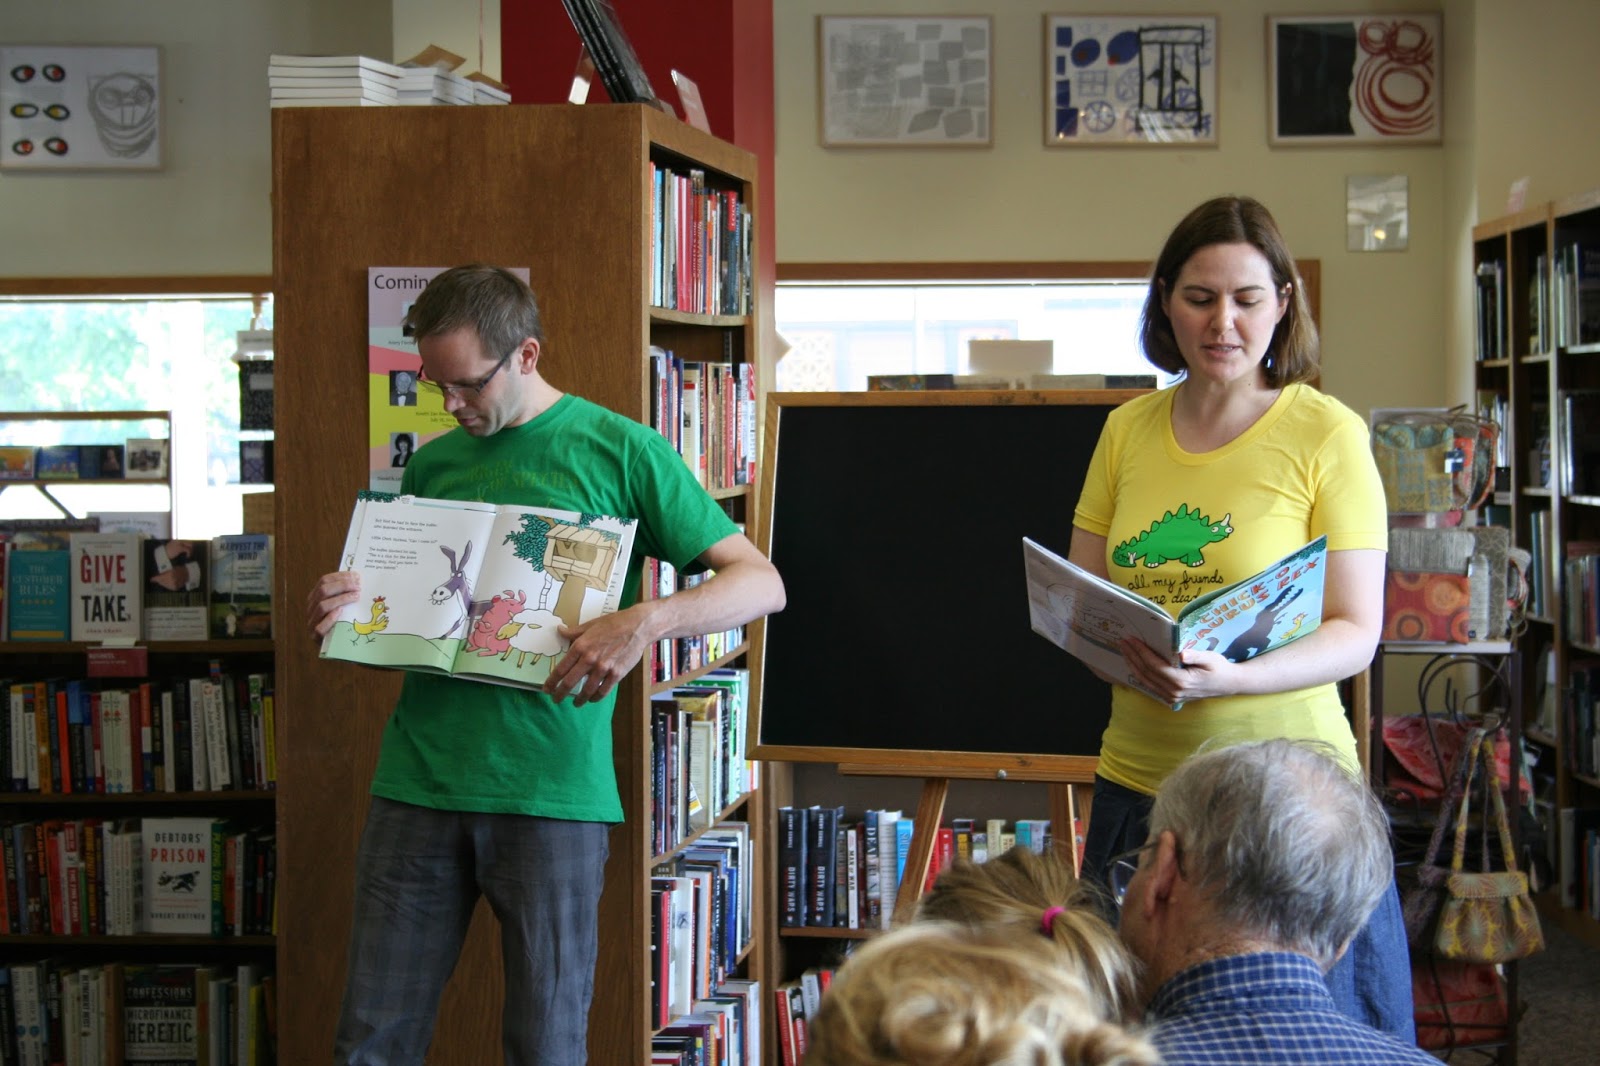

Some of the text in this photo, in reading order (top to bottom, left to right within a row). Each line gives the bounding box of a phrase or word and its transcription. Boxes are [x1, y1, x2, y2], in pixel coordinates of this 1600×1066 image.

[374, 274, 430, 290] Comin
[80, 554, 126, 584] GIVE
[1127, 569, 1224, 593] all my friends
[81, 595, 127, 622] TAKE
[1182, 556, 1320, 651] SAURUS REX
[866, 827, 877, 862] DEAD
[150, 848, 206, 863] PRISON
[212, 870, 222, 881] TO
[788, 866, 796, 889] DIRTY
[817, 865, 825, 889] DIRTY
[212, 883, 222, 903] WIN
[787, 891, 796, 912] WARS
[816, 890, 825, 912] WARS
[127, 987, 193, 999] CONFESSIONS
[127, 1009, 193, 1021] MICROFINANCE
[127, 1023, 193, 1043] HERETIC
